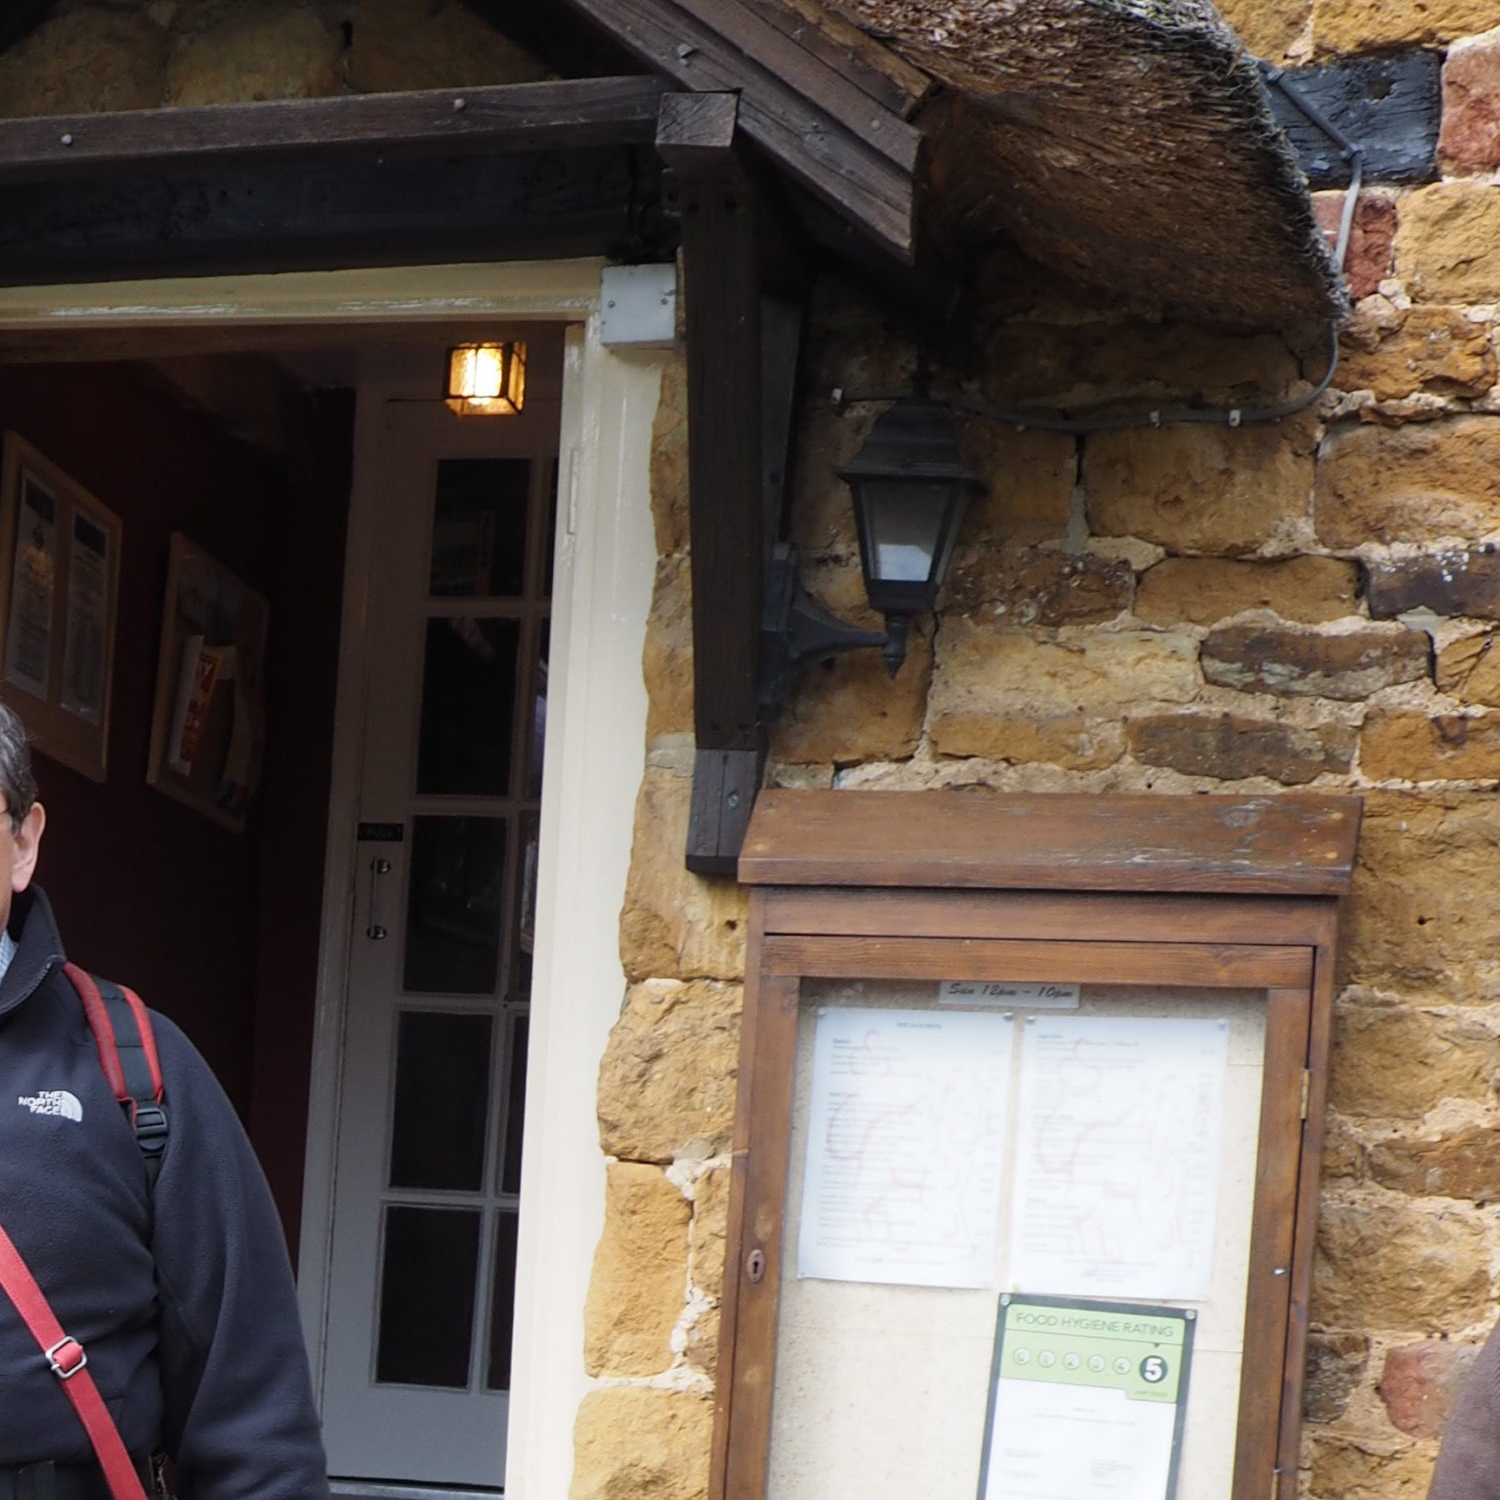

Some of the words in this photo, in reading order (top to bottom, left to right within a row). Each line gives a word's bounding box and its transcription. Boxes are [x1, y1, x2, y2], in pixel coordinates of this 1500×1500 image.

[38, 1091, 62, 1099] THE
[18, 1096, 61, 1107] NORTH
[30, 1105, 61, 1115] FACE
[1016, 1312, 1058, 1326] FOOD
[1061, 1316, 1121, 1332] HYGIENE
[1123, 1322, 1174, 1338] RATING
[1144, 1358, 1163, 1382] 5
